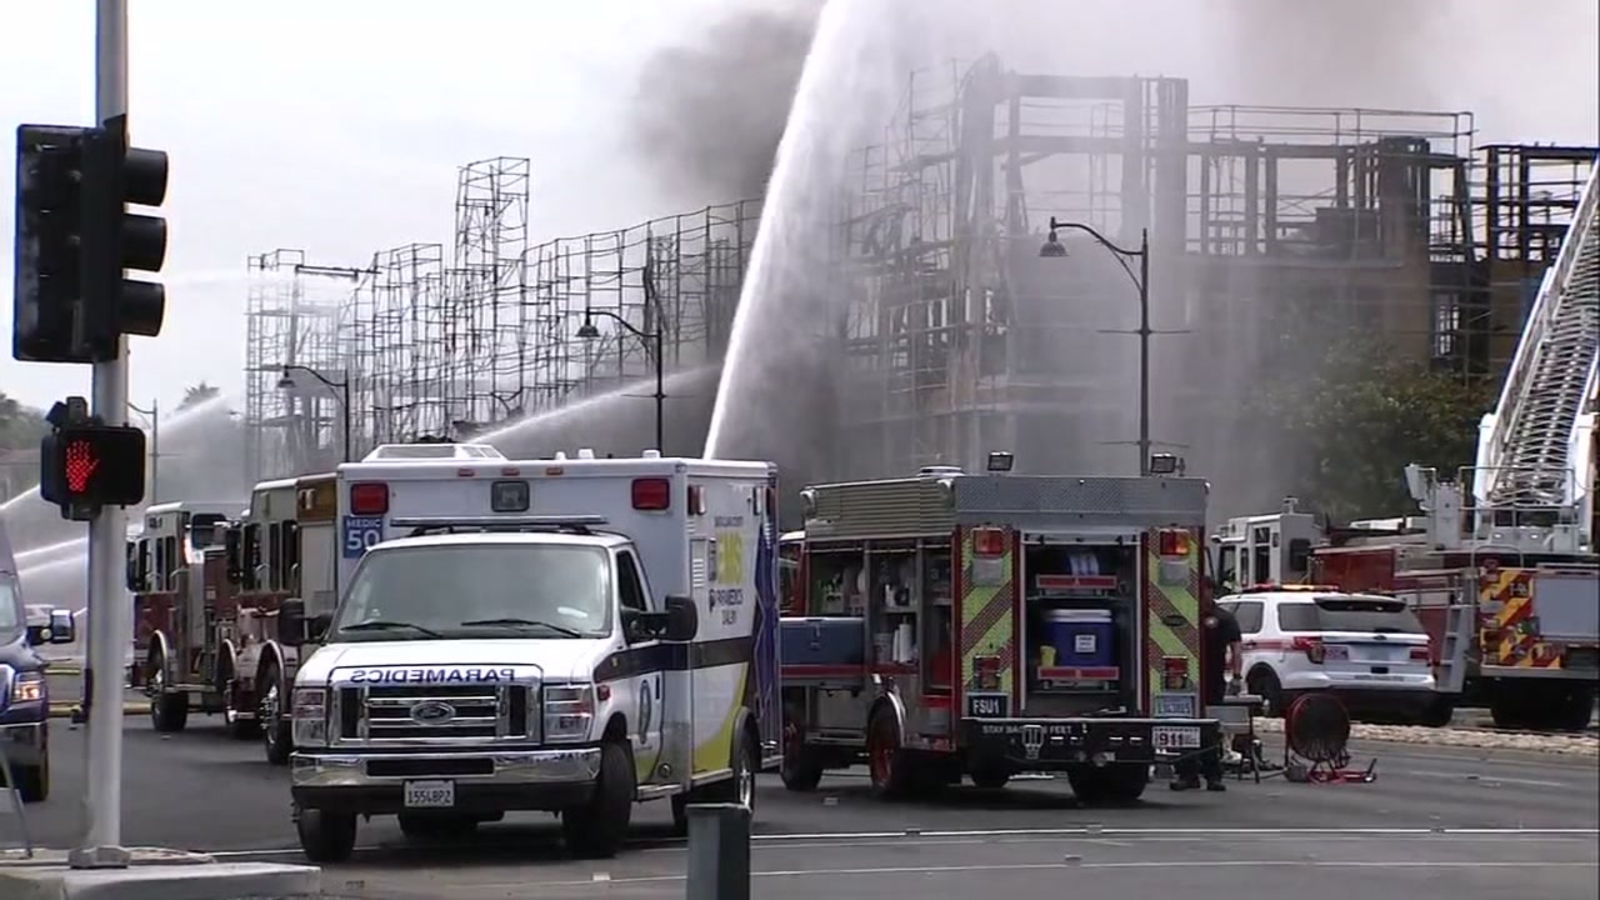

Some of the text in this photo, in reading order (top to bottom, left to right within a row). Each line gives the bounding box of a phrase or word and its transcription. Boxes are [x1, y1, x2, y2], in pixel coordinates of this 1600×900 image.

[346, 518, 381, 528] MEDIC
[347, 530, 380, 549] 50
[973, 699, 1000, 714] FSU1
[1160, 733, 1183, 746] 911
